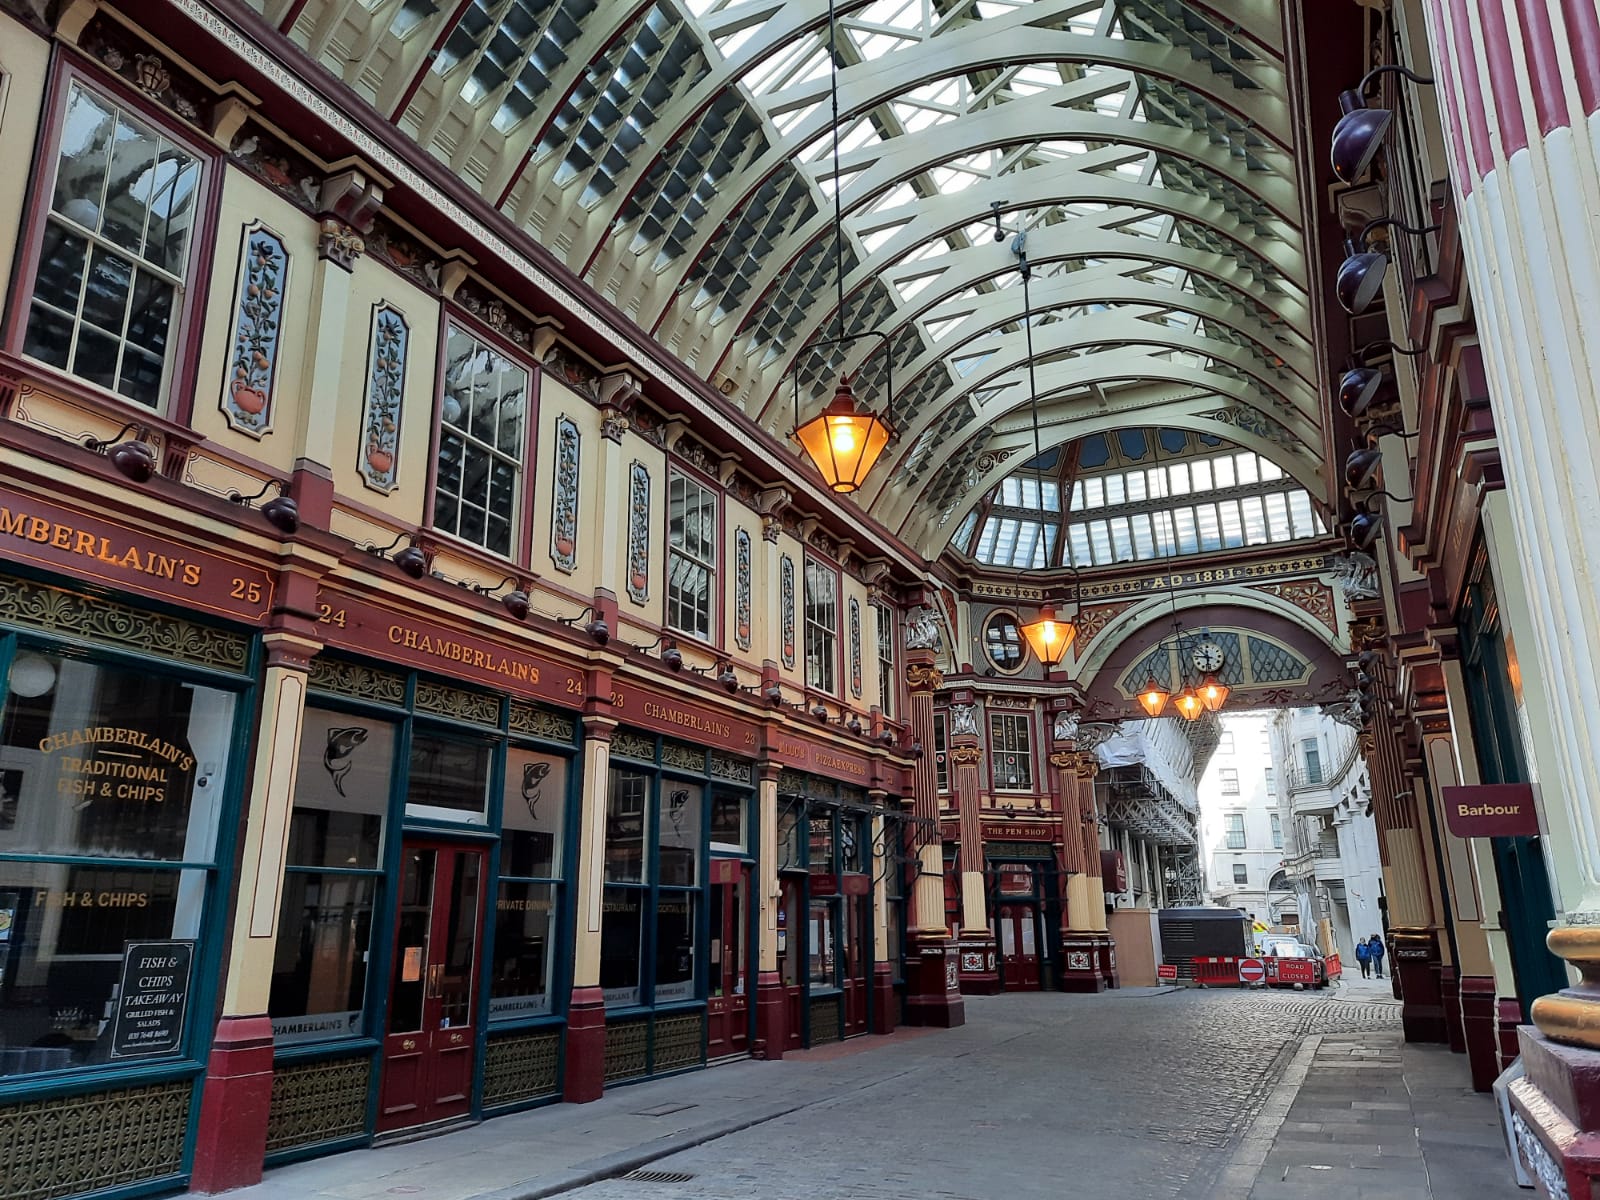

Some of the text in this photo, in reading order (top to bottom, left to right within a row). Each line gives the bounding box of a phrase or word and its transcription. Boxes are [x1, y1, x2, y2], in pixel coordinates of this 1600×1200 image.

[1194, 567, 1235, 584] 1881
[229, 578, 262, 603] 25
[319, 604, 583, 697] 24 CHAMBERLAIN'S 24
[610, 691, 624, 708] 23
[644, 702, 731, 739] CHAMBERLAIN'S
[39, 727, 193, 772] CHAMBERLAIN'S
[61, 757, 168, 782] TRADITIONAL
[57, 777, 165, 802] FISH & CHIPS
[987, 827, 1003, 835] THE
[1024, 828, 1046, 836] SHOP
[80, 891, 93, 907] &
[98, 892, 147, 907] CHIPS
[138, 957, 178, 969] FISH &
[138, 975, 174, 988] CHIPS
[1282, 972, 1310, 980] CLOSED
[125, 993, 184, 1006] TAKEAWAY
